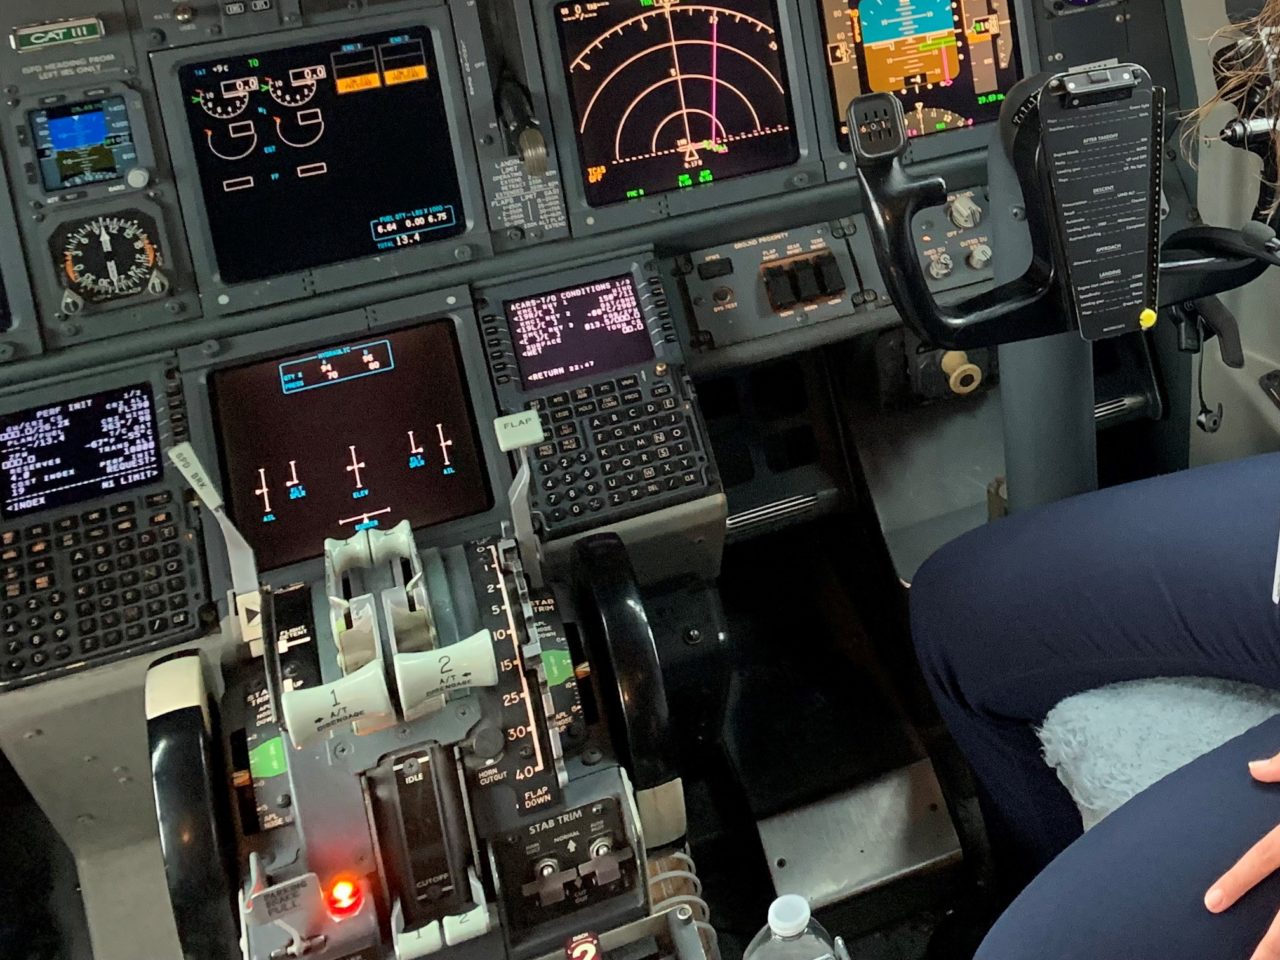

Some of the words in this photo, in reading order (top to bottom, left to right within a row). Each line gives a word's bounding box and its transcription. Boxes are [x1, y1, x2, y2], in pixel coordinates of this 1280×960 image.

[30, 28, 67, 44] CAT
[71, 26, 87, 37] III
[248, 58, 260, 68] TO
[303, 67, 325, 79] 0.0
[235, 80, 257, 91] 0.0
[587, 165, 607, 177] TCAS
[405, 217, 425, 228] 0.00
[427, 212, 447, 223] 6.75
[395, 232, 420, 246] 13.4
[510, 294, 557, 311] ACARS-T/O
[561, 282, 611, 300] CONDITIONS
[36, 406, 62, 418] PERF
[68, 399, 93, 411] INIT
[504, 418, 532, 429] FLAP
[10, 458, 61, 474] RESERVES
[11, 478, 36, 488] COST
[44, 469, 75, 481] INDEX
[12, 488, 25, 496] 19
[487, 584, 495, 593] 2
[491, 605, 500, 615] 5
[534, 604, 555, 612] TRIM
[493, 629, 506, 640] 10
[438, 655, 453, 674] 2
[500, 659, 512, 671] 15
[439, 674, 457, 686] A/T
[426, 679, 472, 696] DISENGAGE
[330, 689, 341, 707] 1
[503, 692, 520, 707] 25
[330, 706, 347, 719] A/T
[317, 710, 365, 732] DISENGAGE
[507, 726, 526, 741] 30
[405, 773, 424, 785] IDLE
[478, 768, 498, 779] HORN
[480, 771, 507, 785] CUTOUT
[515, 766, 534, 781] 40
[524, 786, 548, 800] FLAP
[525, 793, 551, 809] DOWN
[528, 819, 555, 835] STAB
[556, 809, 583, 827] TRIM
[554, 830, 580, 843] NORMAL
[416, 874, 449, 888] CUTOFF
[459, 912, 470, 924] 2
